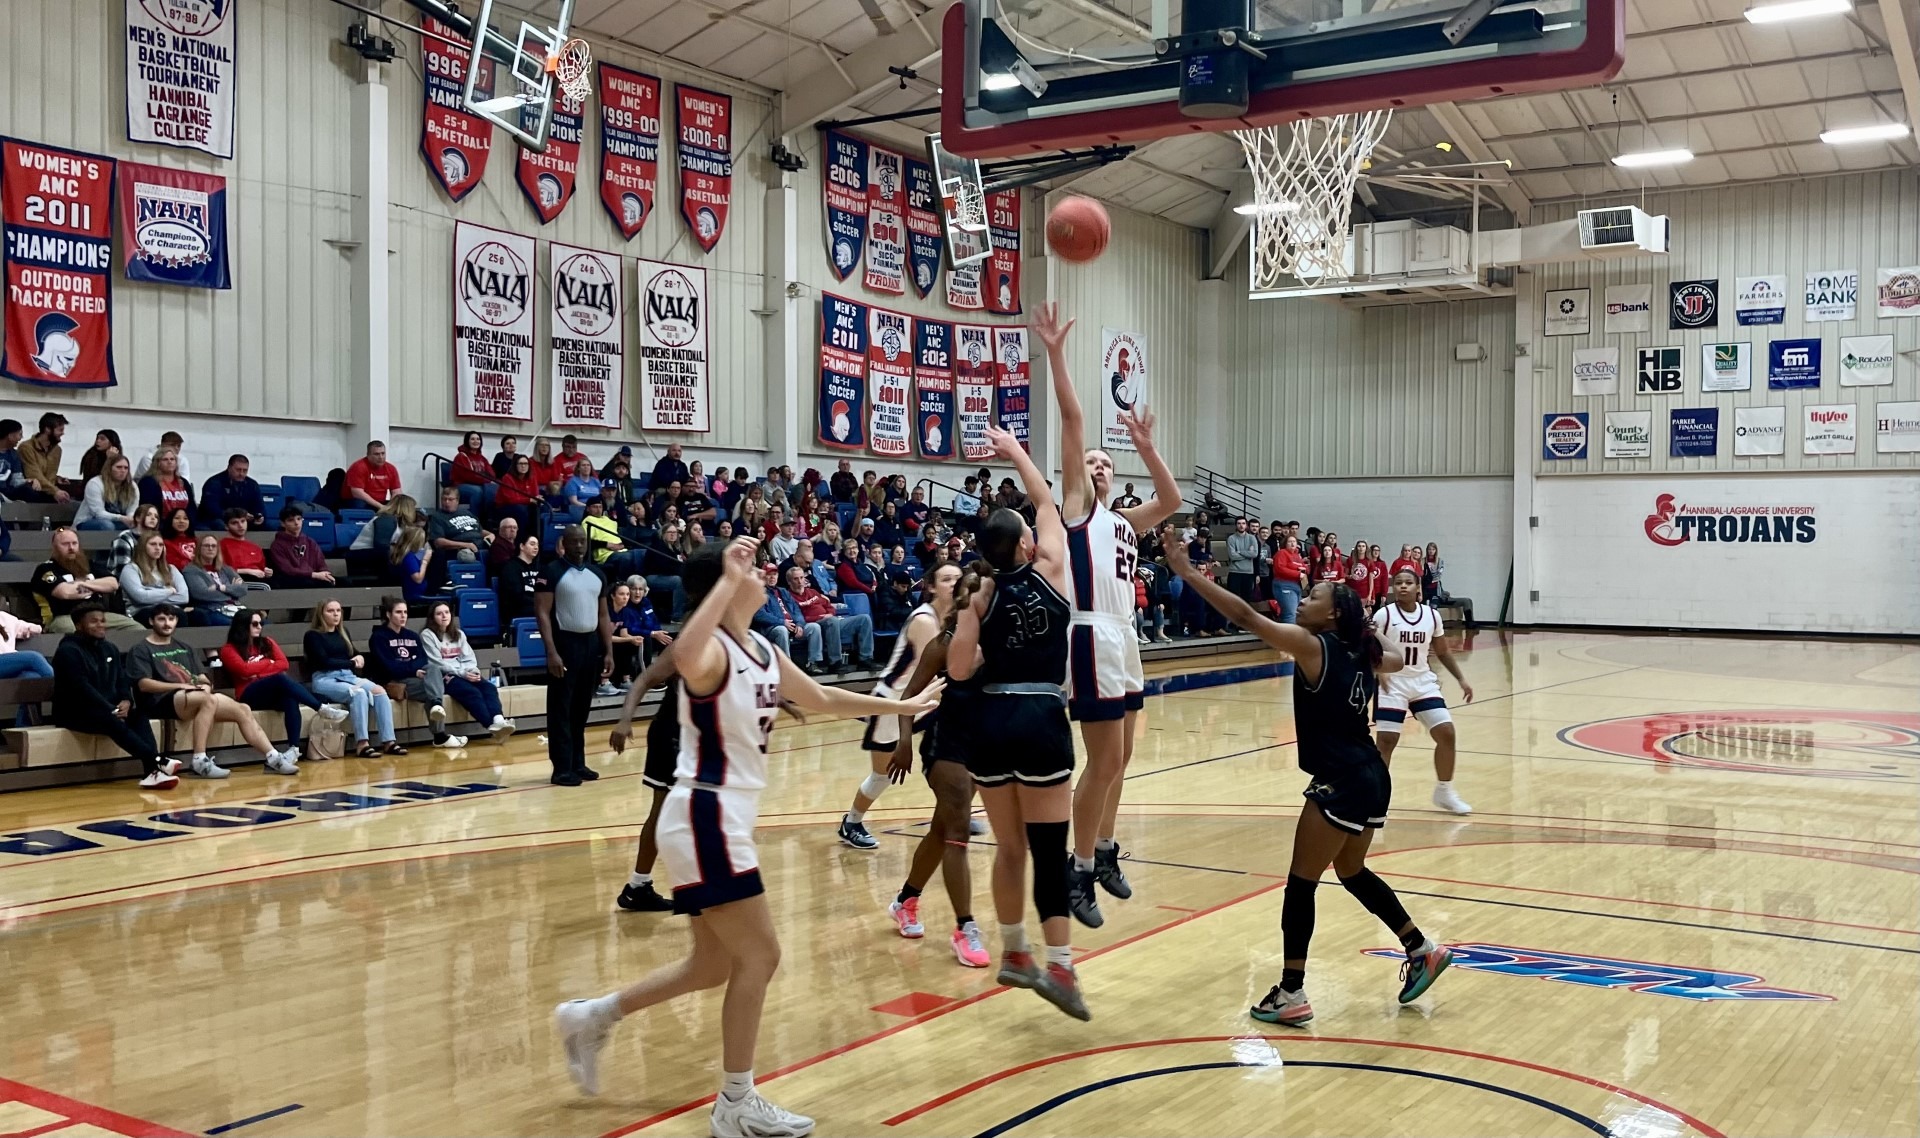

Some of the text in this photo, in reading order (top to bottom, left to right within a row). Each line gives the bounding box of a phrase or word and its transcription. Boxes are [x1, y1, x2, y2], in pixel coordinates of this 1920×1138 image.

[129, 25, 231, 63] MEN'S NATIONAL
[138, 46, 220, 78] BASKETBALL
[138, 63, 220, 95] TOURNAMENT
[609, 76, 652, 100] WOMEN'S
[149, 84, 211, 111] HANNIBAL
[620, 95, 641, 111] AMC
[147, 102, 212, 129] LAGRANGE
[684, 96, 724, 118] WOMEN'S
[444, 114, 468, 131] 25-8
[696, 114, 714, 128] AMC
[154, 121, 208, 145] COLLEGE
[836, 140, 858, 158] MEN'S
[18, 148, 99, 180] WOMEN'S
[620, 162, 642, 176] 24-8
[830, 163, 860, 189] 2006
[38, 174, 79, 198] AMC
[916, 180, 930, 193] AMC
[996, 197, 1009, 209] AMC
[25, 194, 91, 231] 2011
[138, 197, 205, 232] NAIA
[993, 208, 1013, 227] 2011
[148, 229, 197, 243] Champions
[833, 220, 860, 238] SOCCER
[144, 239, 201, 252] of Character
[21, 268, 92, 295] OUTDOOR
[464, 259, 527, 312] NAIA
[1805, 275, 1857, 291] HOME
[56, 292, 67, 311] &
[556, 271, 615, 320] NAIA
[1694, 287, 1713, 304] JOHN'S
[1739, 292, 1783, 300] FARMERS
[1806, 289, 1856, 306] BANK
[646, 287, 699, 331] NAIA
[834, 300, 857, 317] MEN'S
[1684, 295, 1704, 316] JJ
[836, 313, 854, 330] AMC
[877, 312, 906, 337] NAIA
[457, 325, 532, 349] WOMENS NATIONAL
[832, 326, 859, 350] 2011
[961, 329, 988, 348] NAIA
[999, 331, 1022, 349] NAIA
[468, 340, 520, 361] BASKETBALL
[585, 340, 622, 356] NATIONAL
[671, 349, 705, 363] NATIONAL
[468, 353, 521, 375] TOURNAMENT
[559, 351, 611, 367] BASKETBALL
[922, 348, 948, 367] 2012
[1858, 356, 1892, 364] ROLAND
[558, 363, 611, 381] TOURNAMENT
[648, 360, 698, 375] BASKETBALL
[1574, 362, 1617, 375] COUNTRY
[475, 370, 514, 388] HANNIBAL
[564, 379, 605, 394] HANNIBAL
[648, 372, 698, 388] TOURNAMENT
[563, 392, 605, 407] LAGRANGE
[654, 385, 695, 400] HANNIBAL
[828, 384, 856, 401] SOCCER
[878, 384, 904, 405] 2011
[474, 400, 514, 415] COLLEGE
[565, 406, 605, 420] COLLEGE
[652, 398, 696, 412] LAGRANGE
[920, 401, 945, 413] SOCCER
[964, 396, 989, 413] 2012
[656, 412, 693, 426] COLLEGE
[1678, 423, 1714, 431] FINANCIAL
[1878, 419, 1890, 431] H
[1547, 431, 1585, 439] PRESTIGE
[1606, 425, 1645, 435] County
[1614, 432, 1649, 442] Market
[1747, 426, 1784, 434] ADVANCE
[1805, 434, 1832, 442] MARKET
[1686, 506, 1815, 516] HANNIBAL-LAGRANGE UNIVERSITY
[1675, 515, 1816, 543] TROJANS
[1399, 630, 1426, 644] HLGU
[1404, 646, 1418, 666] 11
